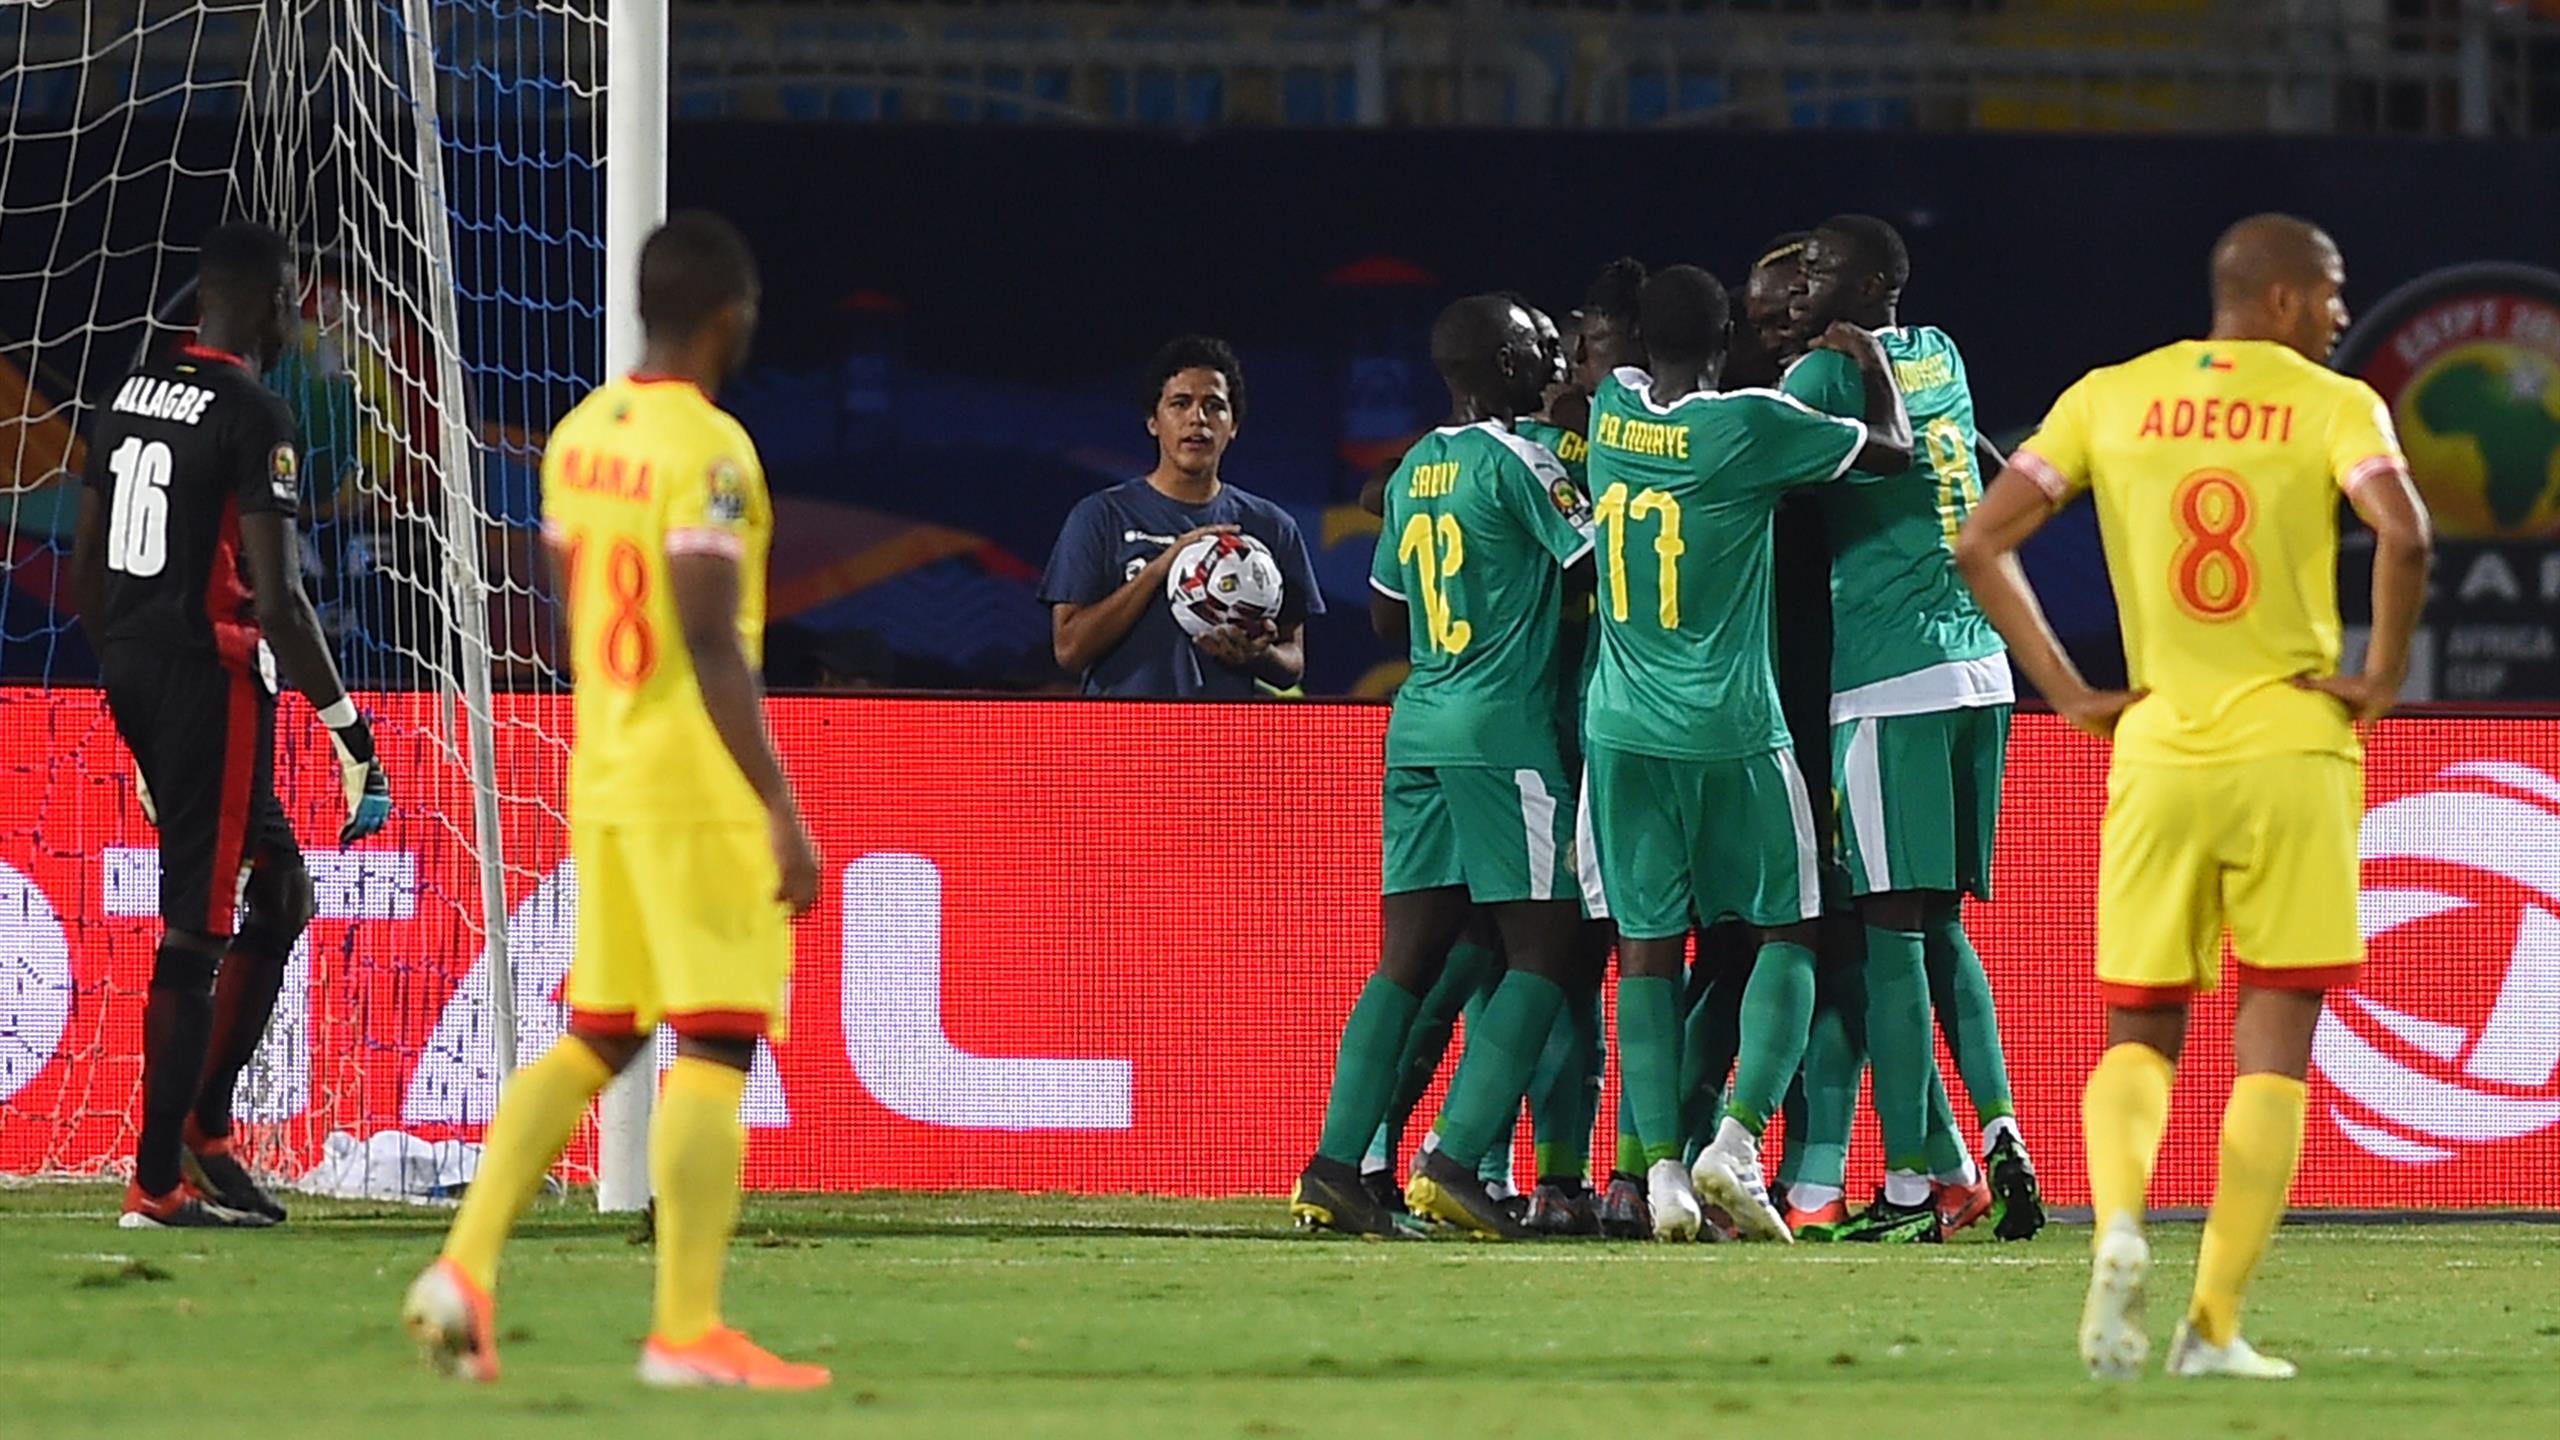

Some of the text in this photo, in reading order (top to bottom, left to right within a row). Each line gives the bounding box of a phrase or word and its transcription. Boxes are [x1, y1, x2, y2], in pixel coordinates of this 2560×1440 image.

[112, 376, 216, 425] ALLAGBE
[2139, 398, 2293, 442] ADEOTI
[108, 436, 173, 577] 16
[1594, 482, 1685, 629] 17
[2168, 466, 2262, 624] 8
[1398, 511, 1471, 655] 12
[0, 847, 1133, 1129] TAL
